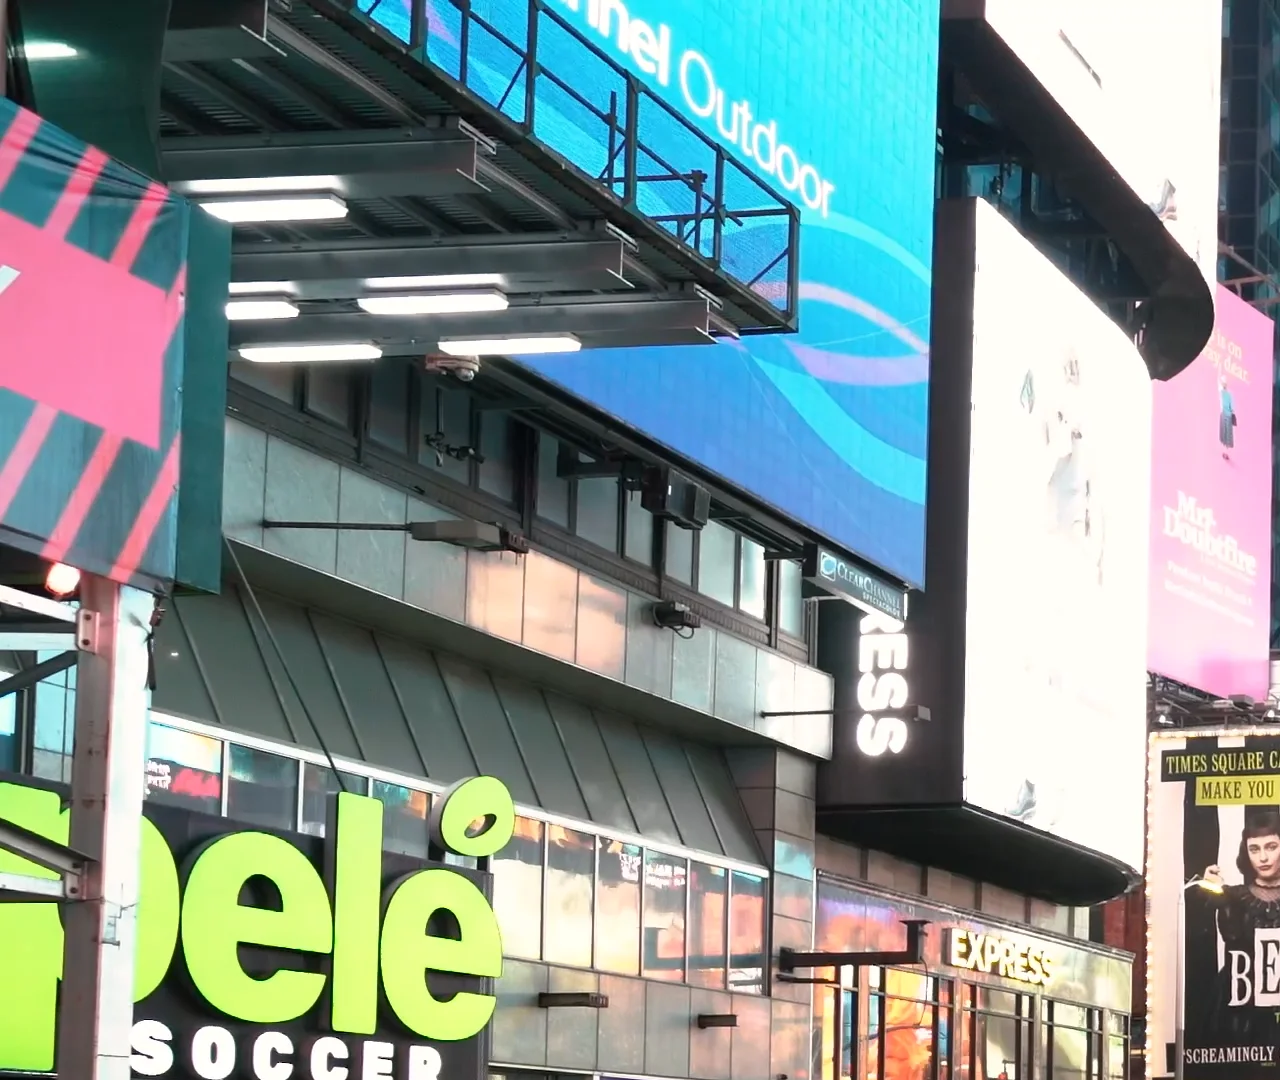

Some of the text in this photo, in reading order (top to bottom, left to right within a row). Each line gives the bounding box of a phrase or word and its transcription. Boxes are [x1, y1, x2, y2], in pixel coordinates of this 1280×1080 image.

[679, 49, 836, 219] Outdoor
[1163, 505, 1257, 576] Doubtfire
[1166, 754, 1208, 774] TIMES
[1211, 751, 1264, 774] SQUARE
[1201, 780, 1242, 800] MAKE
[1247, 780, 1275, 798] YOU
[950, 927, 1052, 986] EXPRESS
